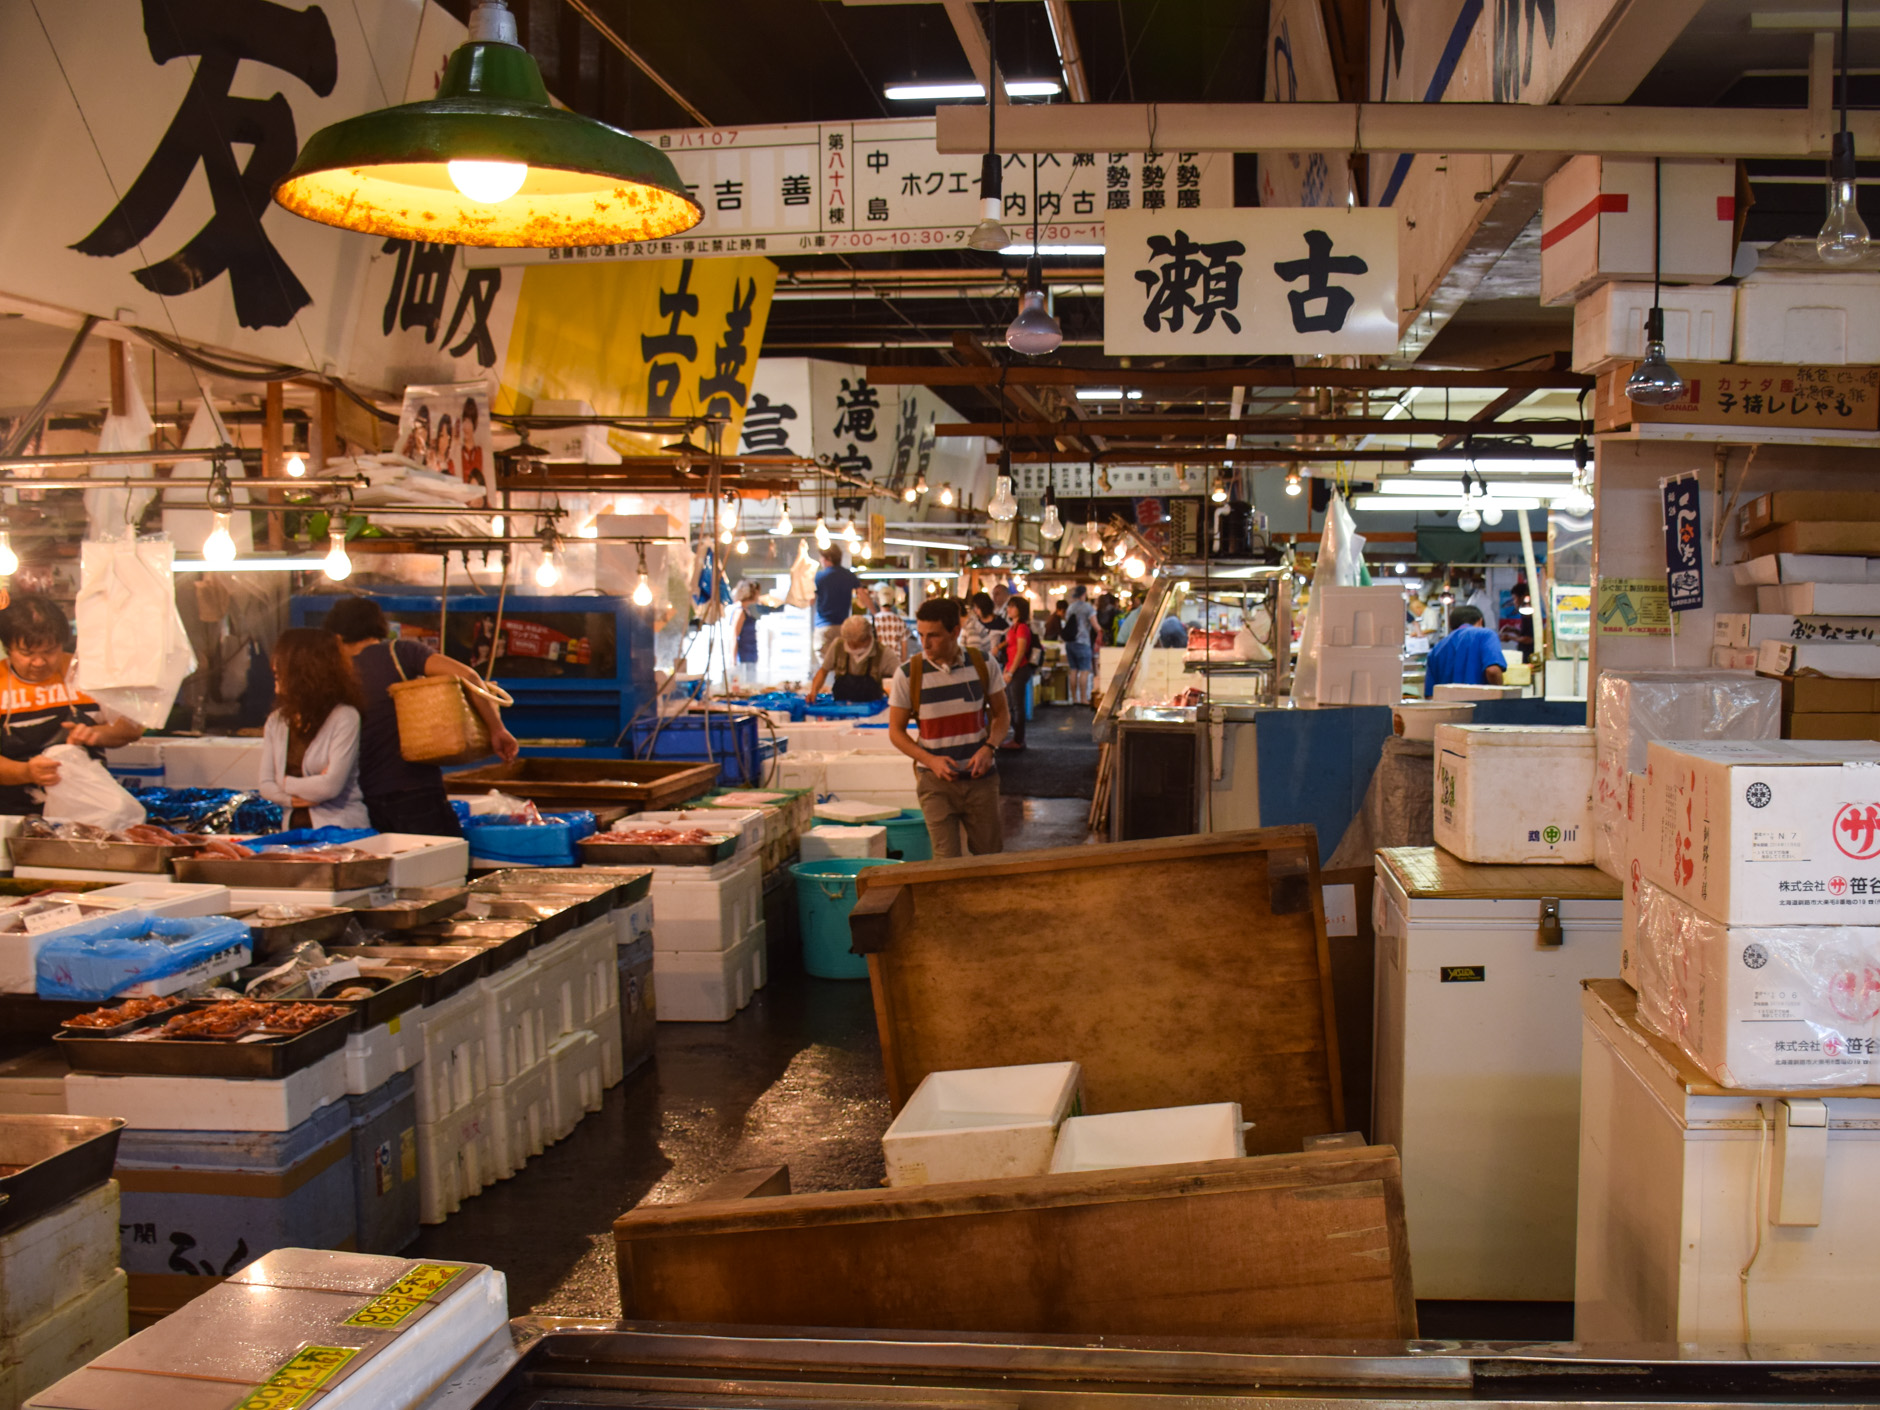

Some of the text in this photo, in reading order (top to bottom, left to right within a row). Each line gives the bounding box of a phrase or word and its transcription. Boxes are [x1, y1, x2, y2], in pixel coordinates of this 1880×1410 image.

[828, 133, 845, 225] 第八十八棟
[1135, 229, 1368, 334] 瀬古
[1718, 378, 1795, 394] カナダ産
[1664, 404, 1699, 412] CANADA
[1, 688, 31, 709] ALL
[1779, 880, 1826, 893] 株式会社
[1775, 1040, 1821, 1052] 株式会社
